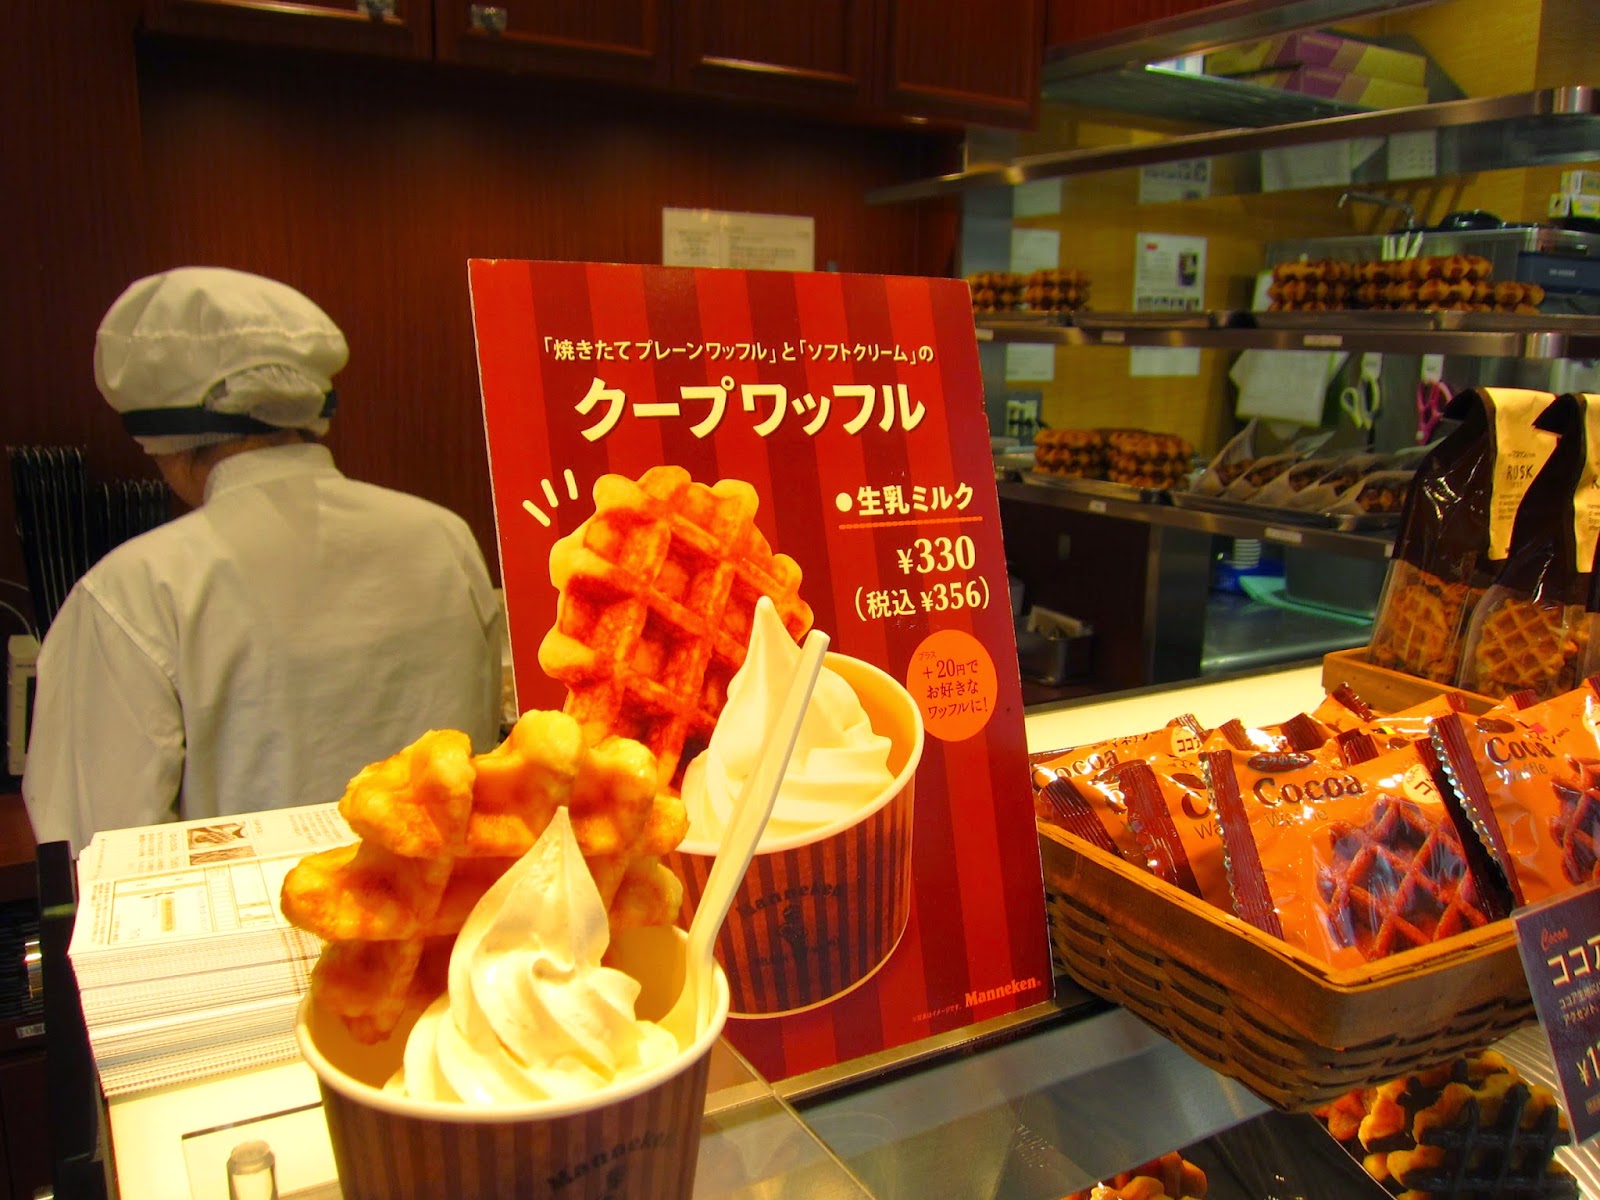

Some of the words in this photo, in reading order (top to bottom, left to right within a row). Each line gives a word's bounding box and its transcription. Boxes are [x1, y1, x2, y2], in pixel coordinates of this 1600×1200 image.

[574, 375, 926, 442] クープワッフル
[1506, 464, 1534, 480] RUSK
[896, 535, 976, 575] ¥330
[927, 679, 979, 699] お好きな
[1252, 775, 1365, 807] Cocoa
[1264, 809, 1329, 828] Wale
[1576, 1040, 1600, 1088] ¥1
